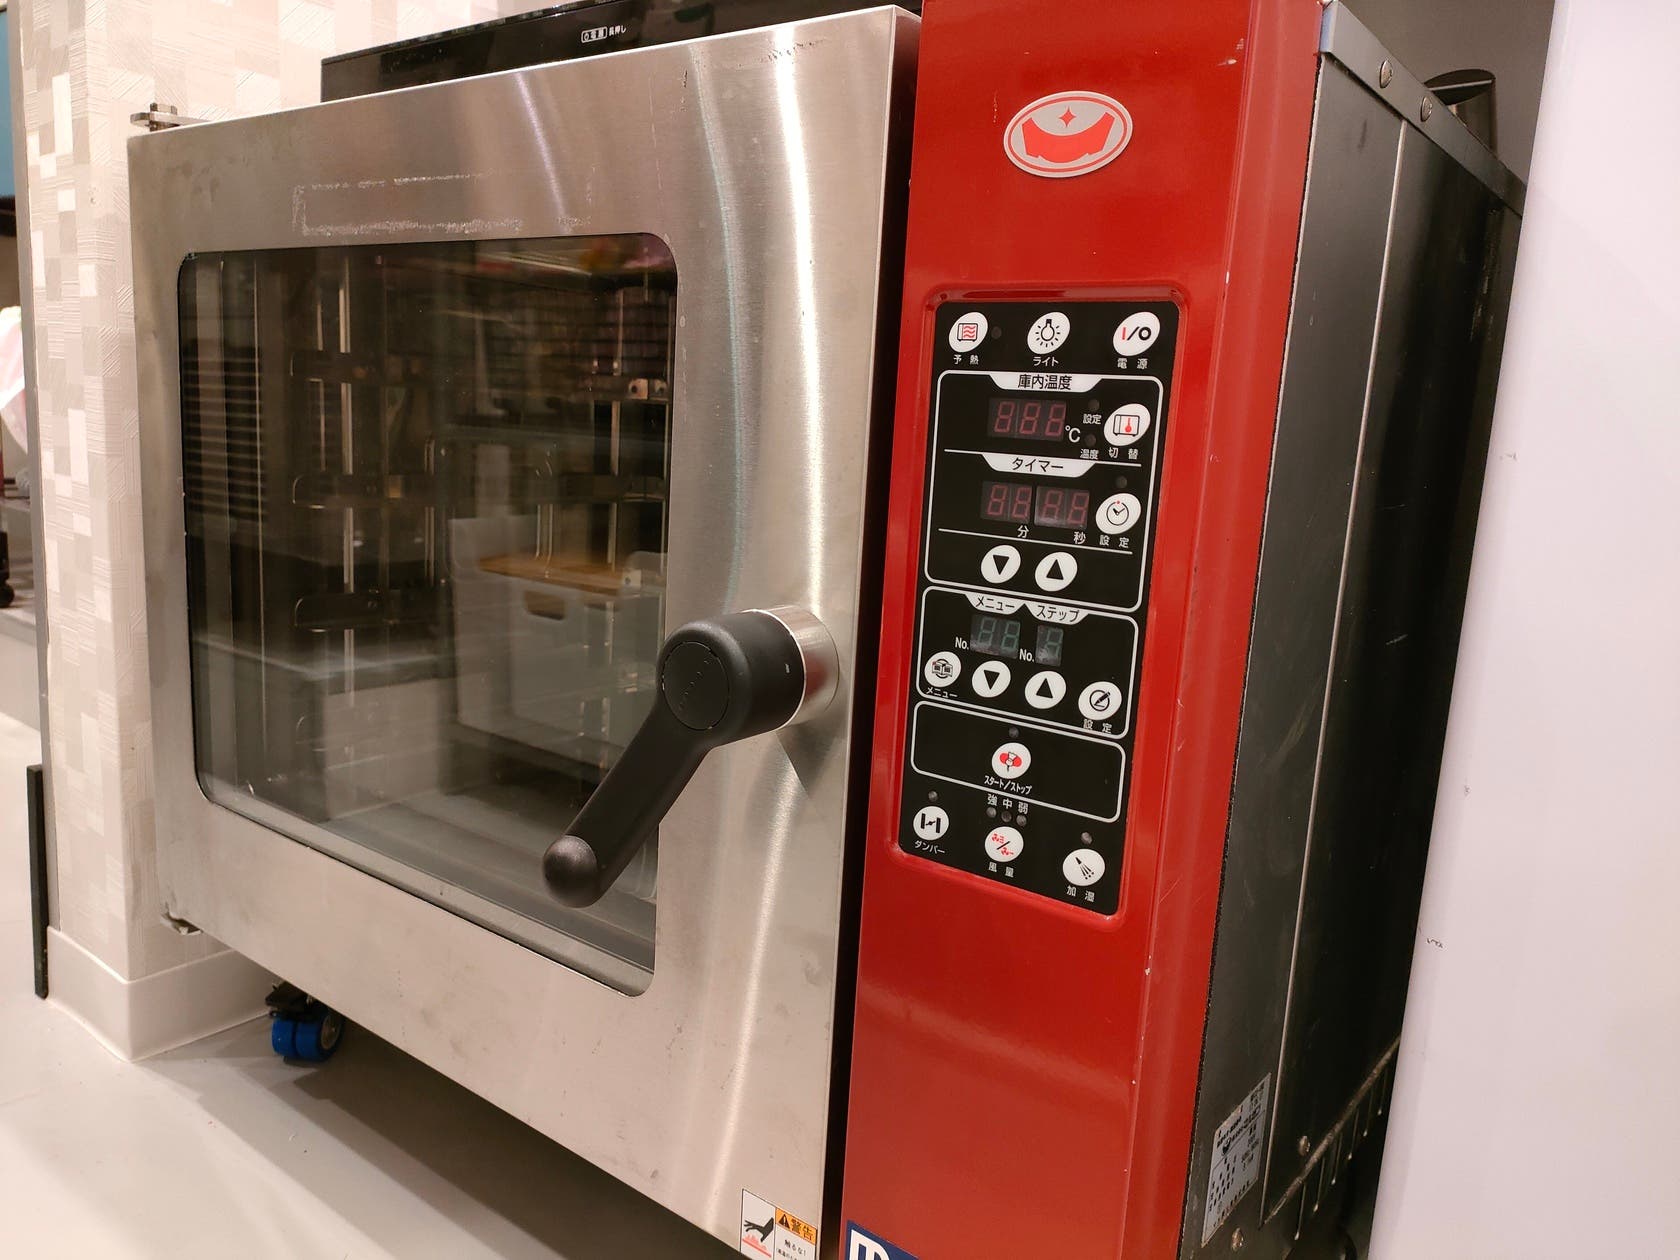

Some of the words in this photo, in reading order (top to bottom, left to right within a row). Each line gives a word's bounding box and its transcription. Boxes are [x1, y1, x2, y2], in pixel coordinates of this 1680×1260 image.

[953, 354, 979, 366] 予熱
[1032, 356, 1059, 367] ライト
[1117, 357, 1148, 370] 電源
[1017, 374, 1072, 391] 庫内温度
[1083, 413, 1101, 425] 設定
[1080, 448, 1099, 460] 温度
[1108, 448, 1139, 460] 切替
[1012, 457, 1064, 473] タイマー
[1017, 525, 1030, 539] 分
[1073, 531, 1087, 545] 秒
[1099, 535, 1130, 549] 設定
[975, 595, 1015, 611] メニュー
[1036, 604, 1080, 623] ステップ
[955, 636, 970, 650] No.
[1019, 648, 1035, 662] No.
[926, 686, 958, 698] メニュー
[1083, 718, 1113, 734] 設定
[987, 793, 998, 806] 強
[1003, 797, 1013, 810] 中
[1018, 801, 1029, 814] 弱
[988, 862, 1015, 878] 風量
